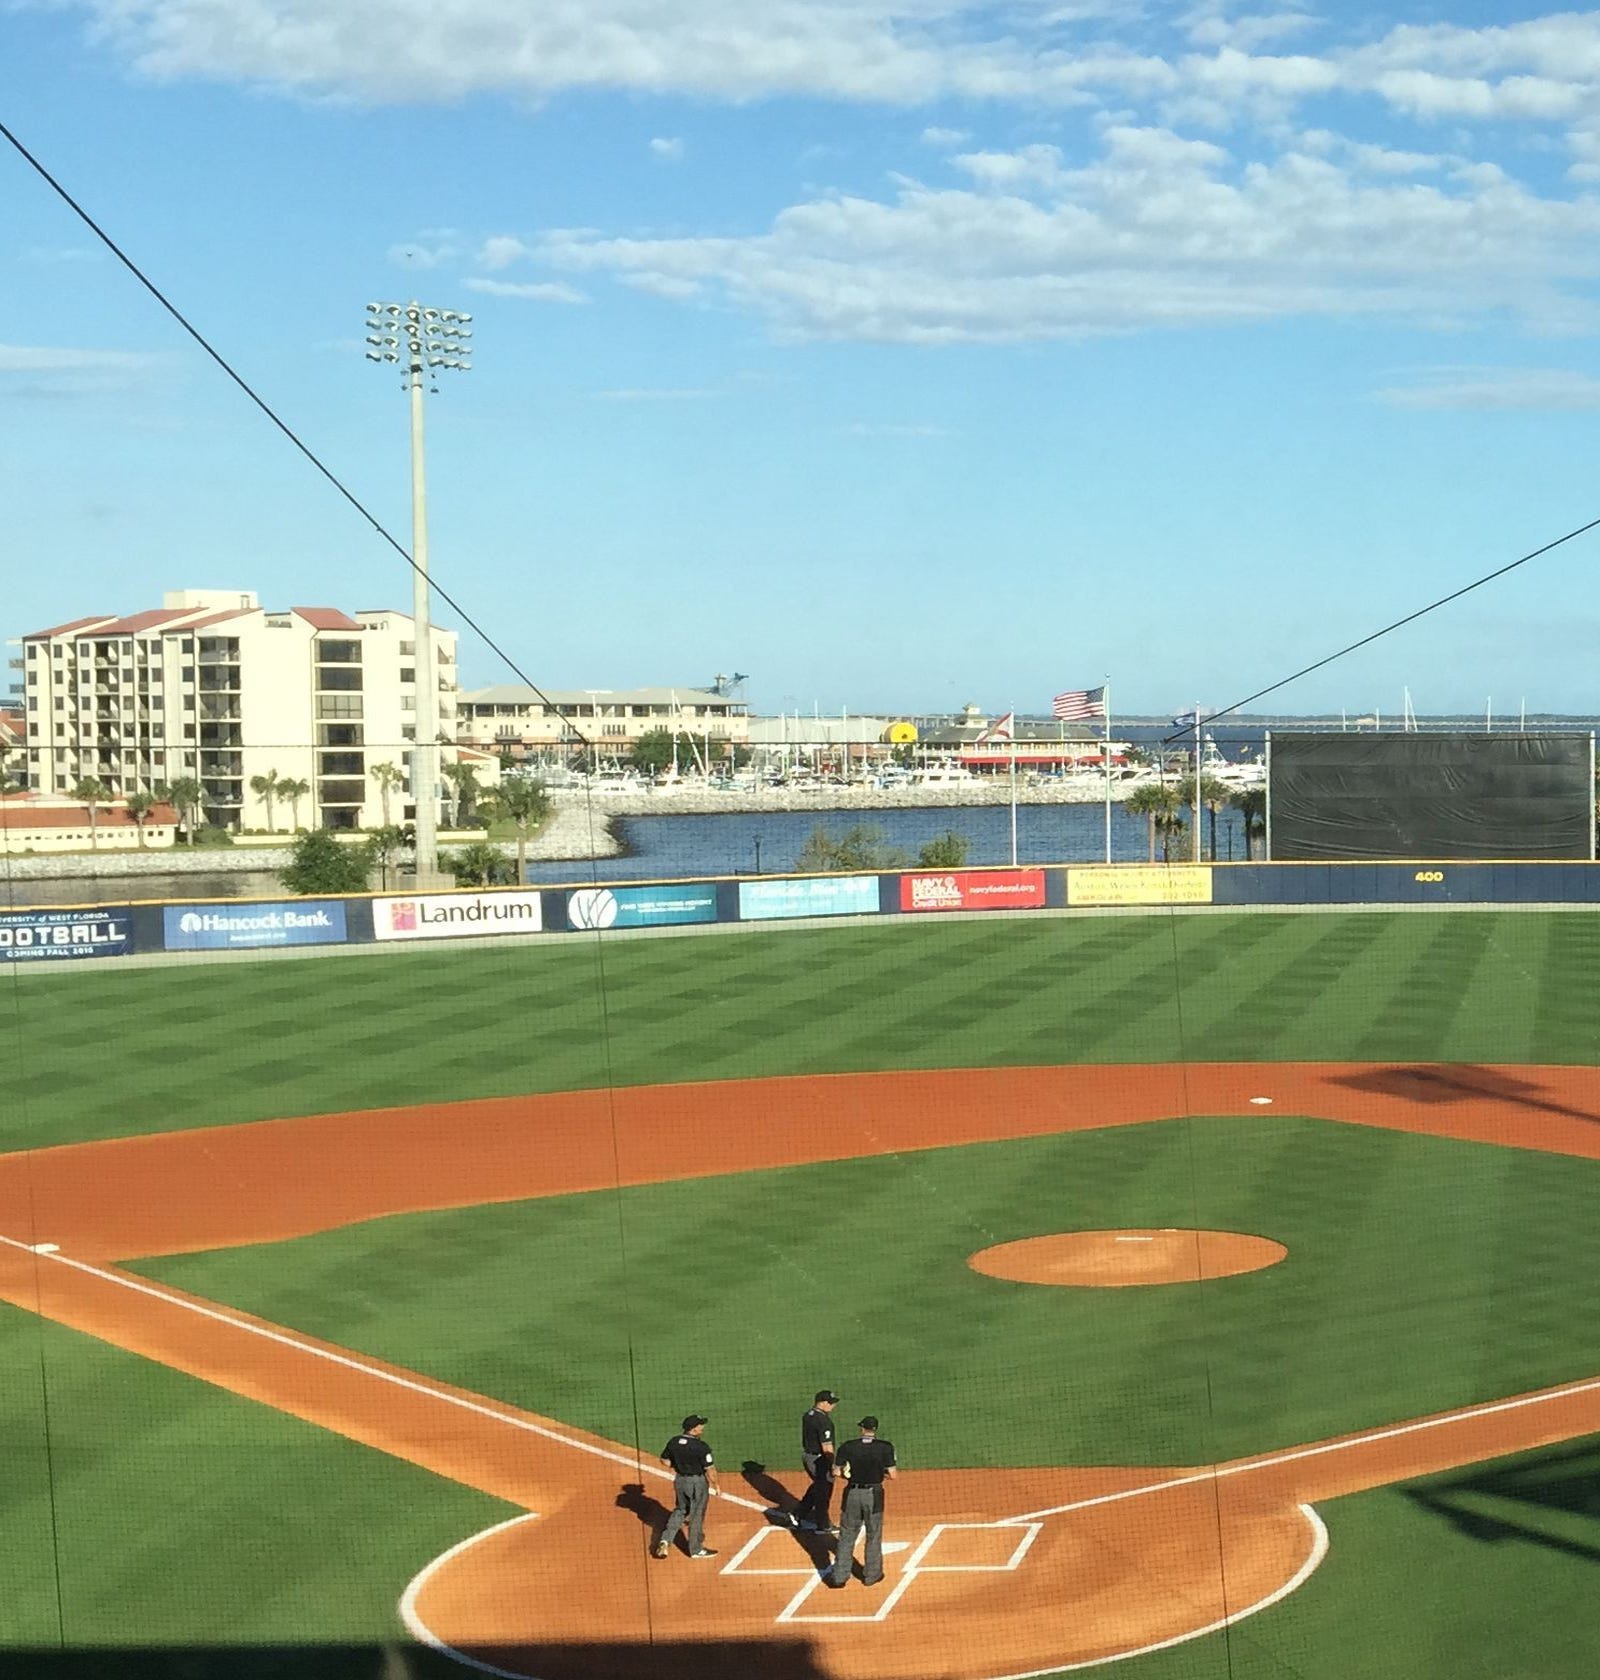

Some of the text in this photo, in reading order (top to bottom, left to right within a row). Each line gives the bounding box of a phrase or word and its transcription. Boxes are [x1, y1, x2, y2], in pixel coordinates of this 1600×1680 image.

[1415, 871, 1444, 881] 400
[912, 878, 944, 890] NAVY
[912, 886, 961, 898] FEDERAL
[73, 912, 109, 920] FLORIDA
[421, 900, 532, 923] Landrum
[204, 911, 328, 931] Hancock Bank
